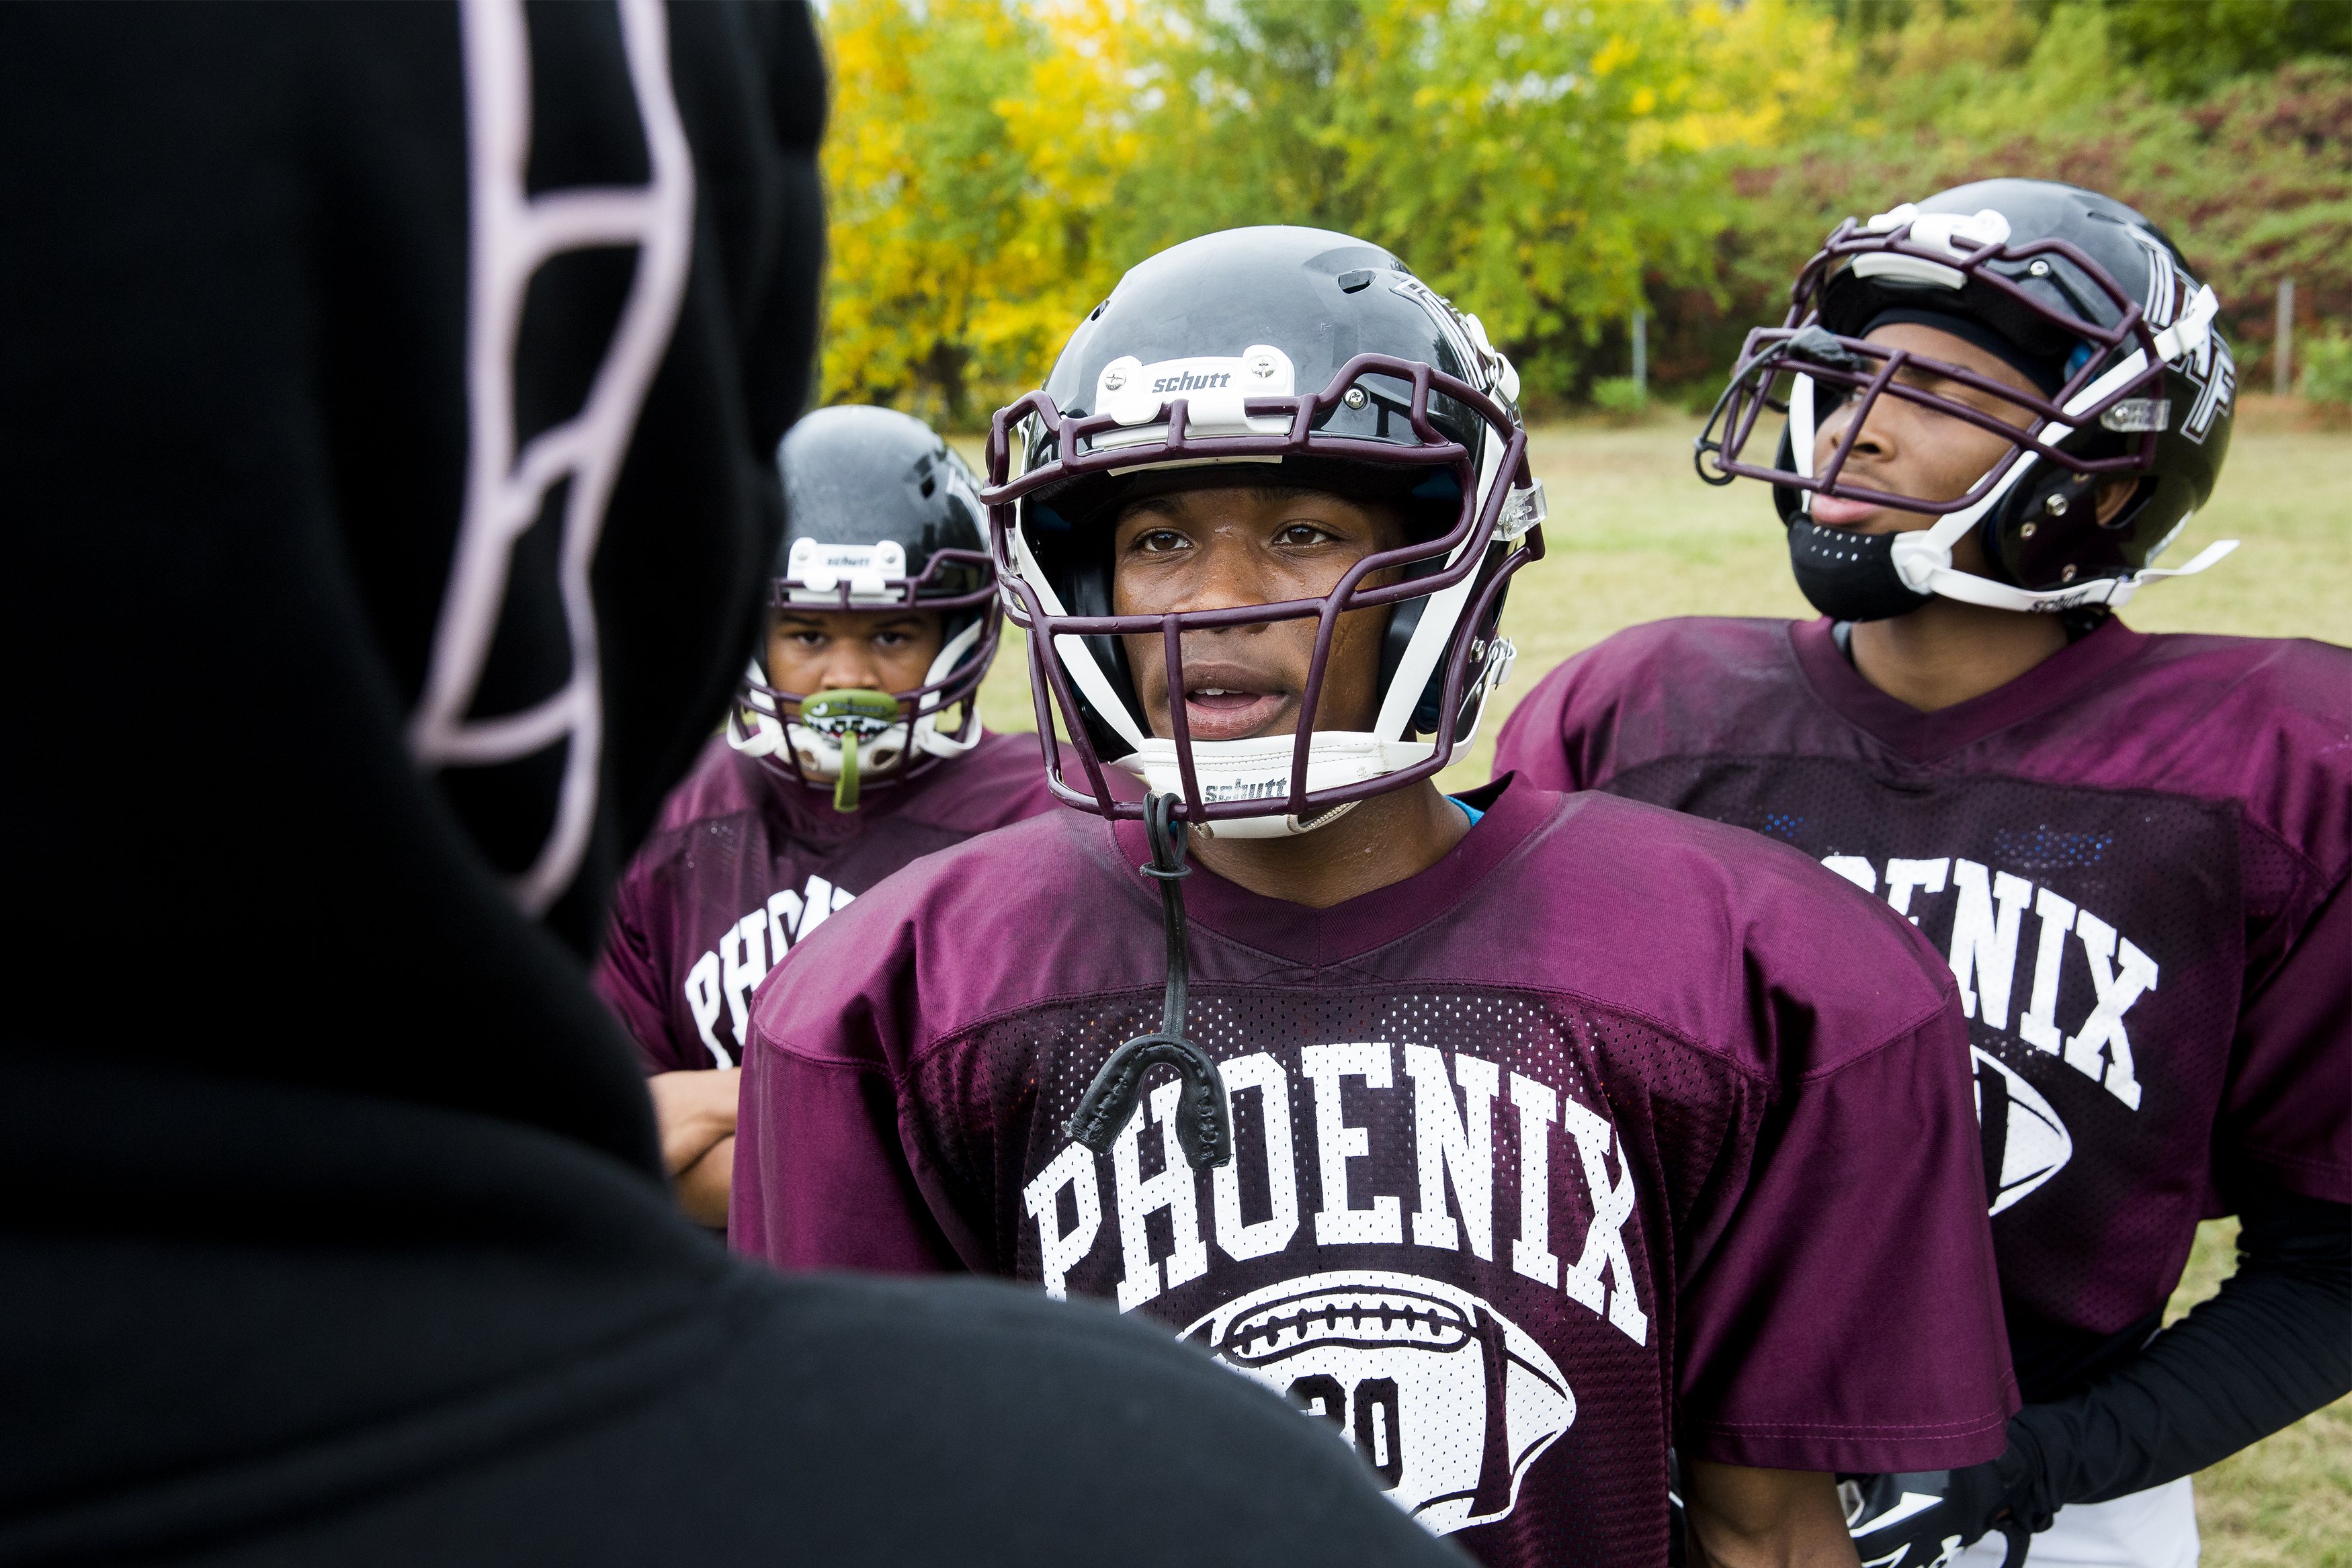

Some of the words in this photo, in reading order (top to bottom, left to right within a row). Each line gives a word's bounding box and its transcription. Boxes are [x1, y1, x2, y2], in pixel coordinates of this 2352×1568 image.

[1151, 371, 1231, 393] schutt
[1205, 777, 1287, 802] schutt
[1023, 1042, 1648, 1347] PHOENIX
